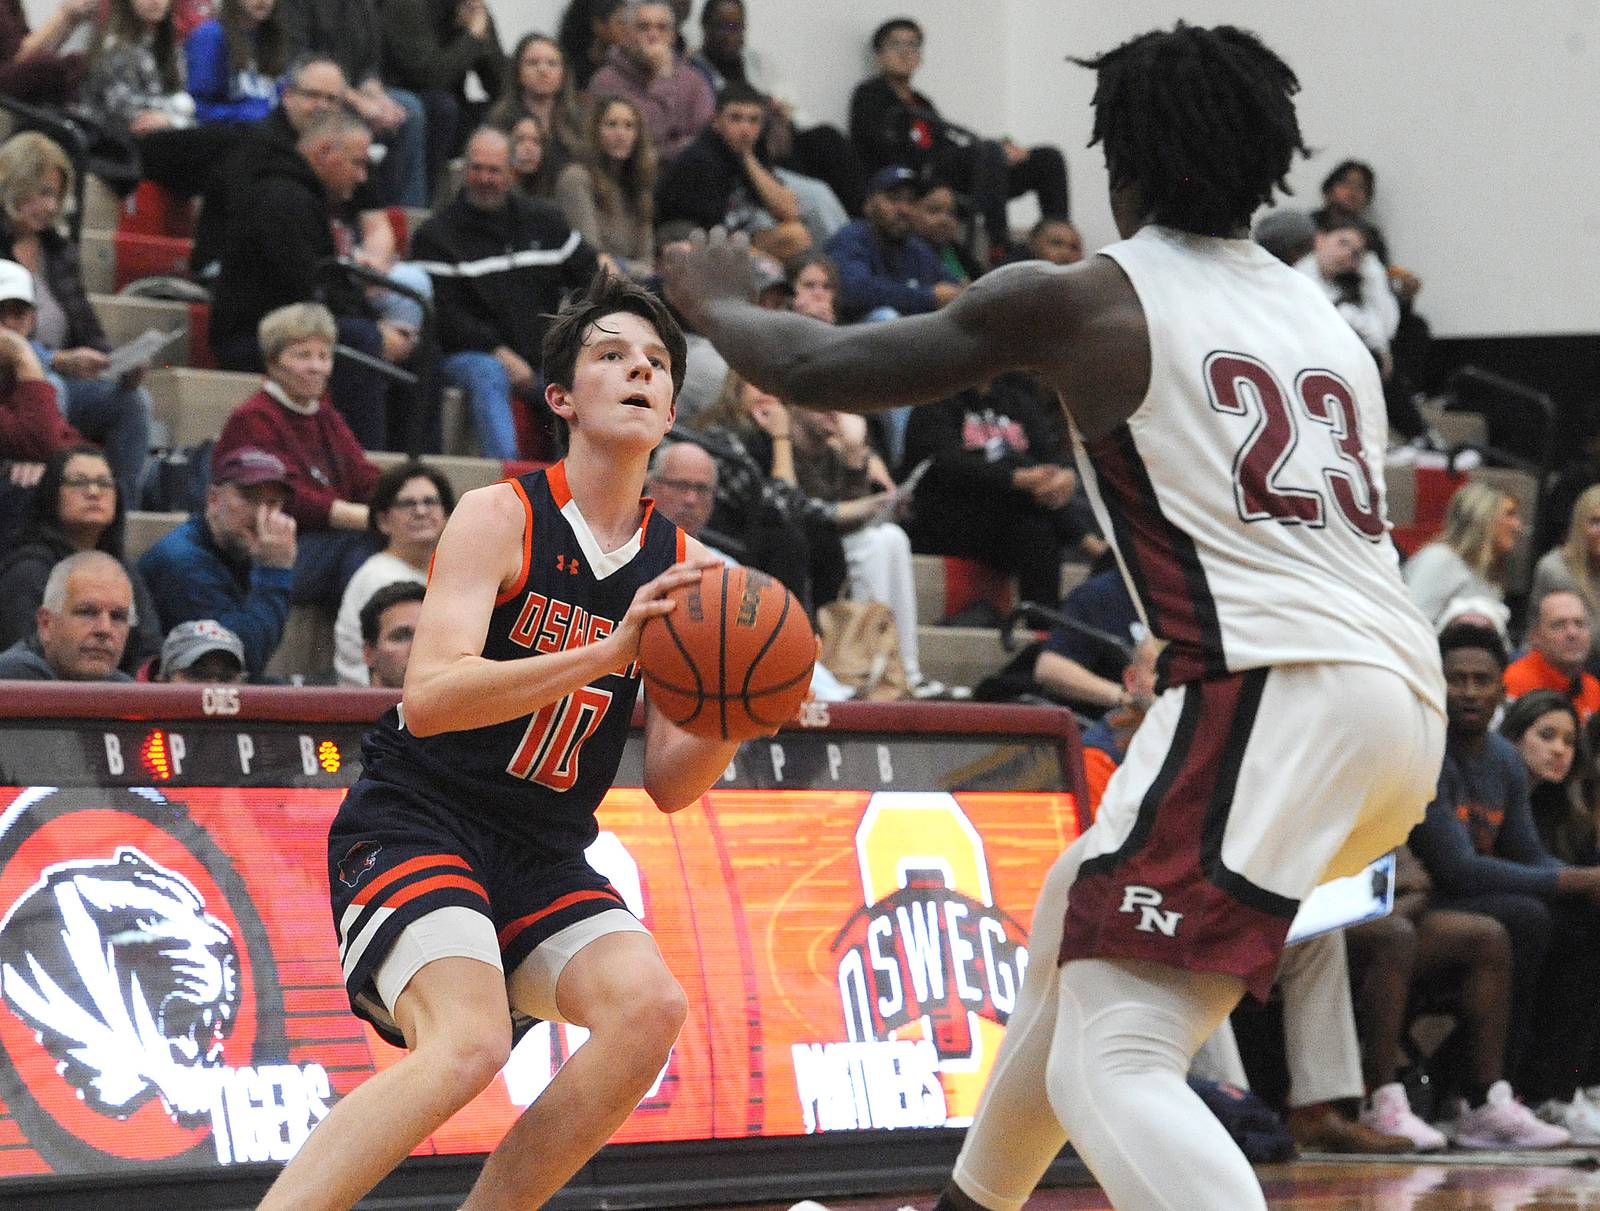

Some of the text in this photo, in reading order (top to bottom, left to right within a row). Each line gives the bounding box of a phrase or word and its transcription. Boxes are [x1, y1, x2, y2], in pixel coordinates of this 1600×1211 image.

[1203, 350, 1382, 543] 23
[508, 591, 640, 679] OSWE
[104, 733, 318, 776] B P P B
[506, 686, 613, 793] 10
[770, 743, 786, 782] P
[827, 743, 842, 781] P
